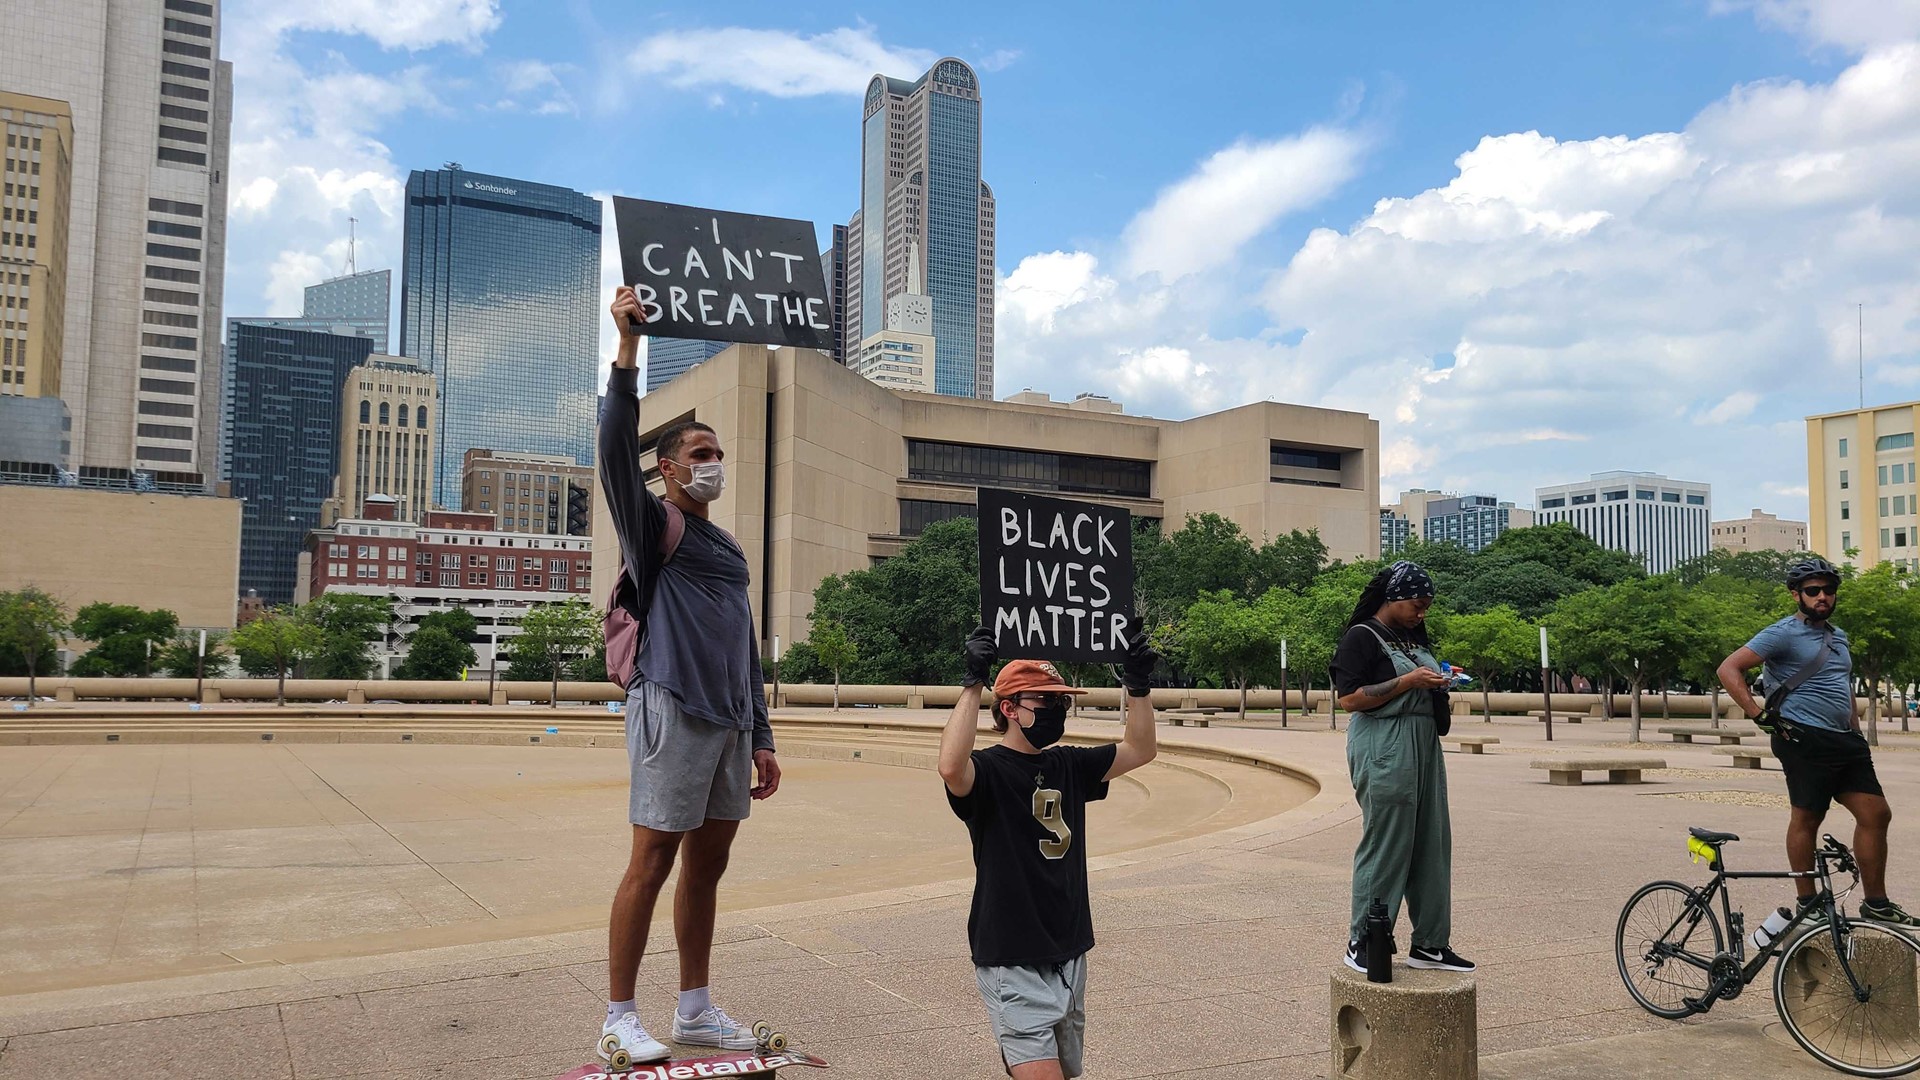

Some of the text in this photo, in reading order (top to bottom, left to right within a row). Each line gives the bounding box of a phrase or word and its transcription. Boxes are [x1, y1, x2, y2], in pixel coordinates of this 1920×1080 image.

[474, 181, 518, 196] Santander
[712, 217, 721, 245] I
[642, 243, 804, 284] CAN'T
[634, 283, 830, 330] BREATHE
[1001, 507, 1118, 558] BLACK
[999, 555, 1111, 608] LIVES
[994, 605, 1130, 652] MATTER
[1032, 787, 1072, 860] 9
